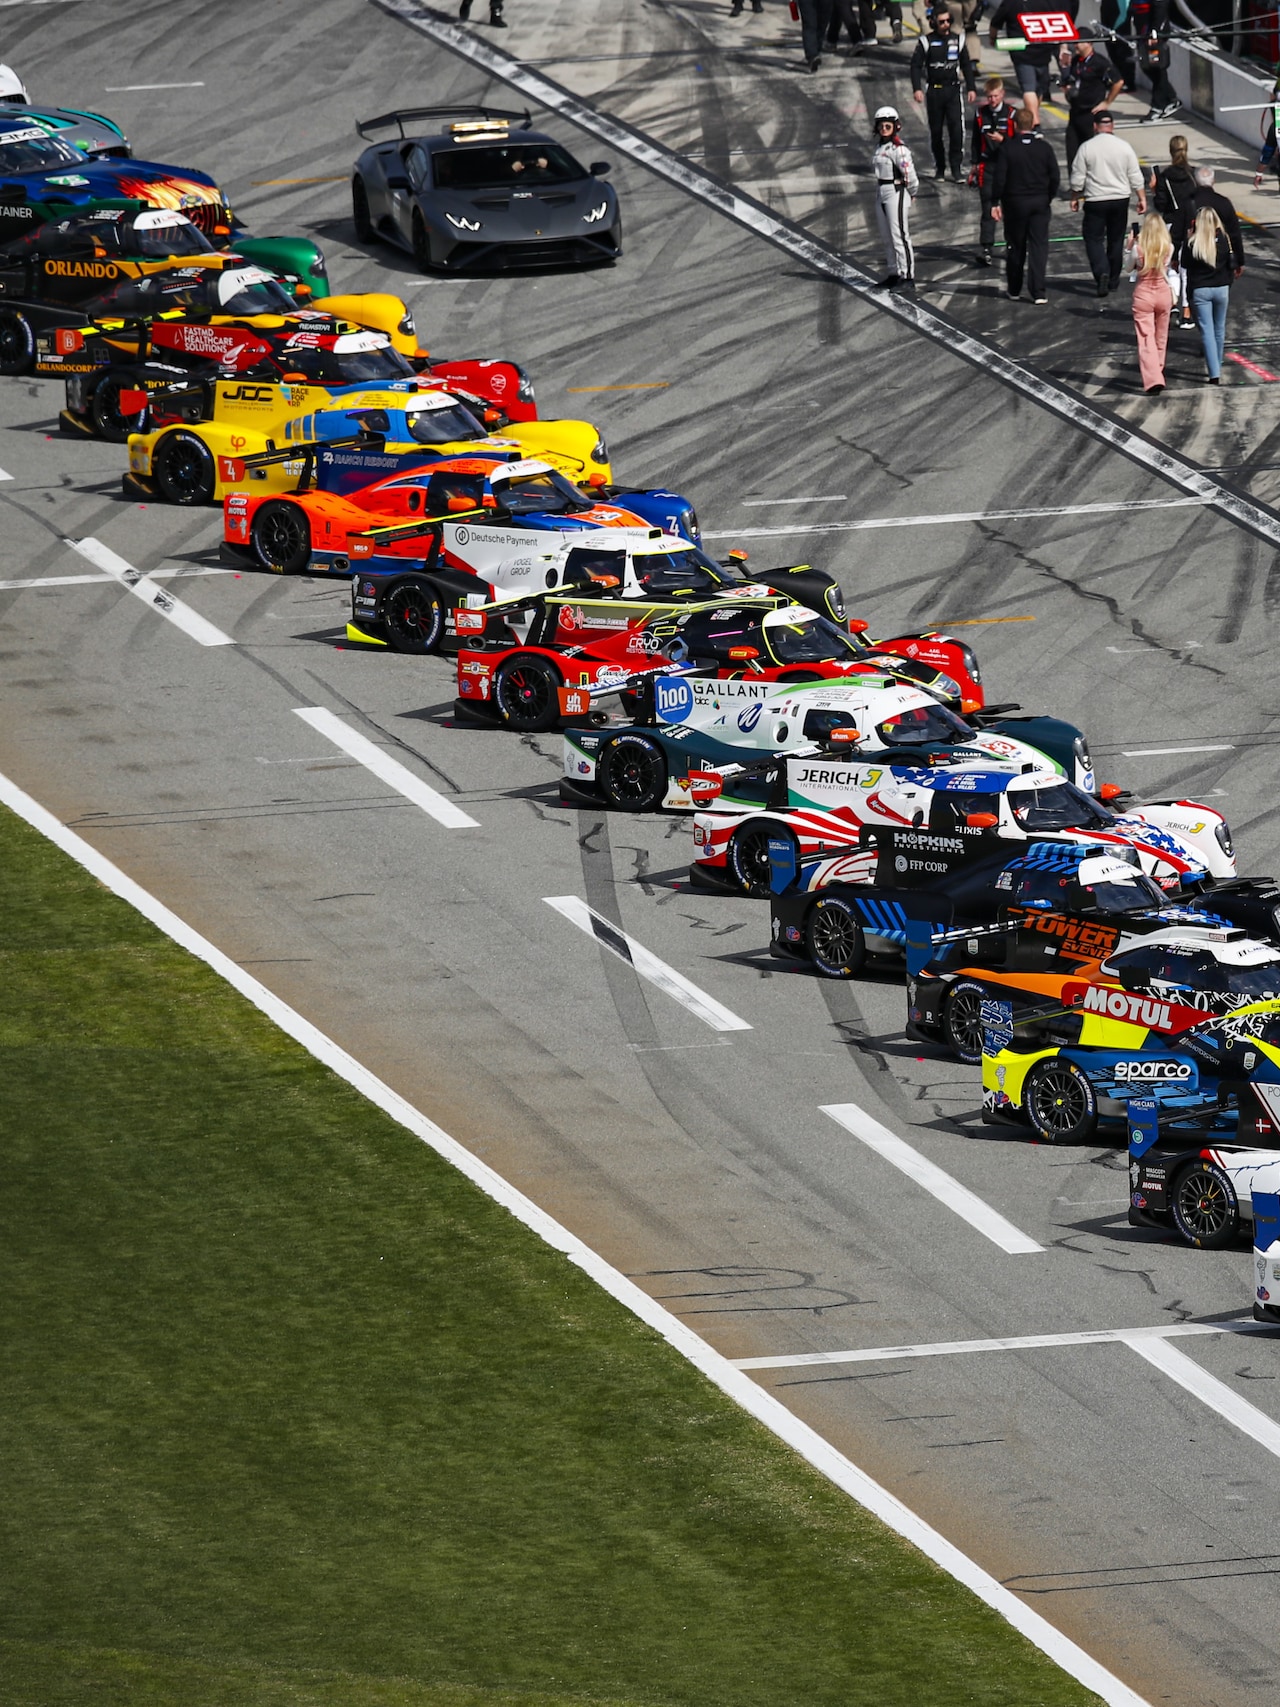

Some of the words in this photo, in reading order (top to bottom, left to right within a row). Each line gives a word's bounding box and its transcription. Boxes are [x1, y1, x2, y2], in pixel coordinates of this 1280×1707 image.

[45, 260, 118, 279] ORLANDO
[184, 327, 215, 337] FASTMD
[184, 335, 233, 346] HEALTHCARE
[185, 343, 228, 354] SOLUTIONS
[222, 386, 273, 402] JDC
[291, 387, 309, 395] RACE
[335, 454, 363, 466] RANCH
[364, 456, 399, 469] RESORT
[666, 515, 681, 537] 74
[471, 533, 505, 543] Deutsche
[506, 535, 538, 546] Payment
[514, 558, 532, 566] VOGEL
[511, 567, 531, 576] GROUP
[629, 637, 659, 650] CRYO
[658, 685, 688, 709] hoo
[693, 681, 769, 699] GALLANT
[567, 693, 581, 704] uh
[796, 769, 859, 785] JERICH
[800, 782, 859, 792] INTERNATIONAL
[1165, 821, 1190, 831] JERICH
[894, 832, 964, 849] HOPKINS
[894, 843, 965, 854] INVESTMENTS
[910, 860, 924, 871] FFP
[926, 861, 948, 873] CORP
[1022, 908, 1118, 948] TOWER
[1062, 940, 1113, 959] EVENTS
[1084, 986, 1173, 1029] MOTUL
[1114, 1062, 1191, 1081] sparco
[1079, 1074, 1094, 1113] MICHELIN
[1142, 1182, 1163, 1191] MOTUL
[1213, 1168, 1234, 1202] MICHELIN
